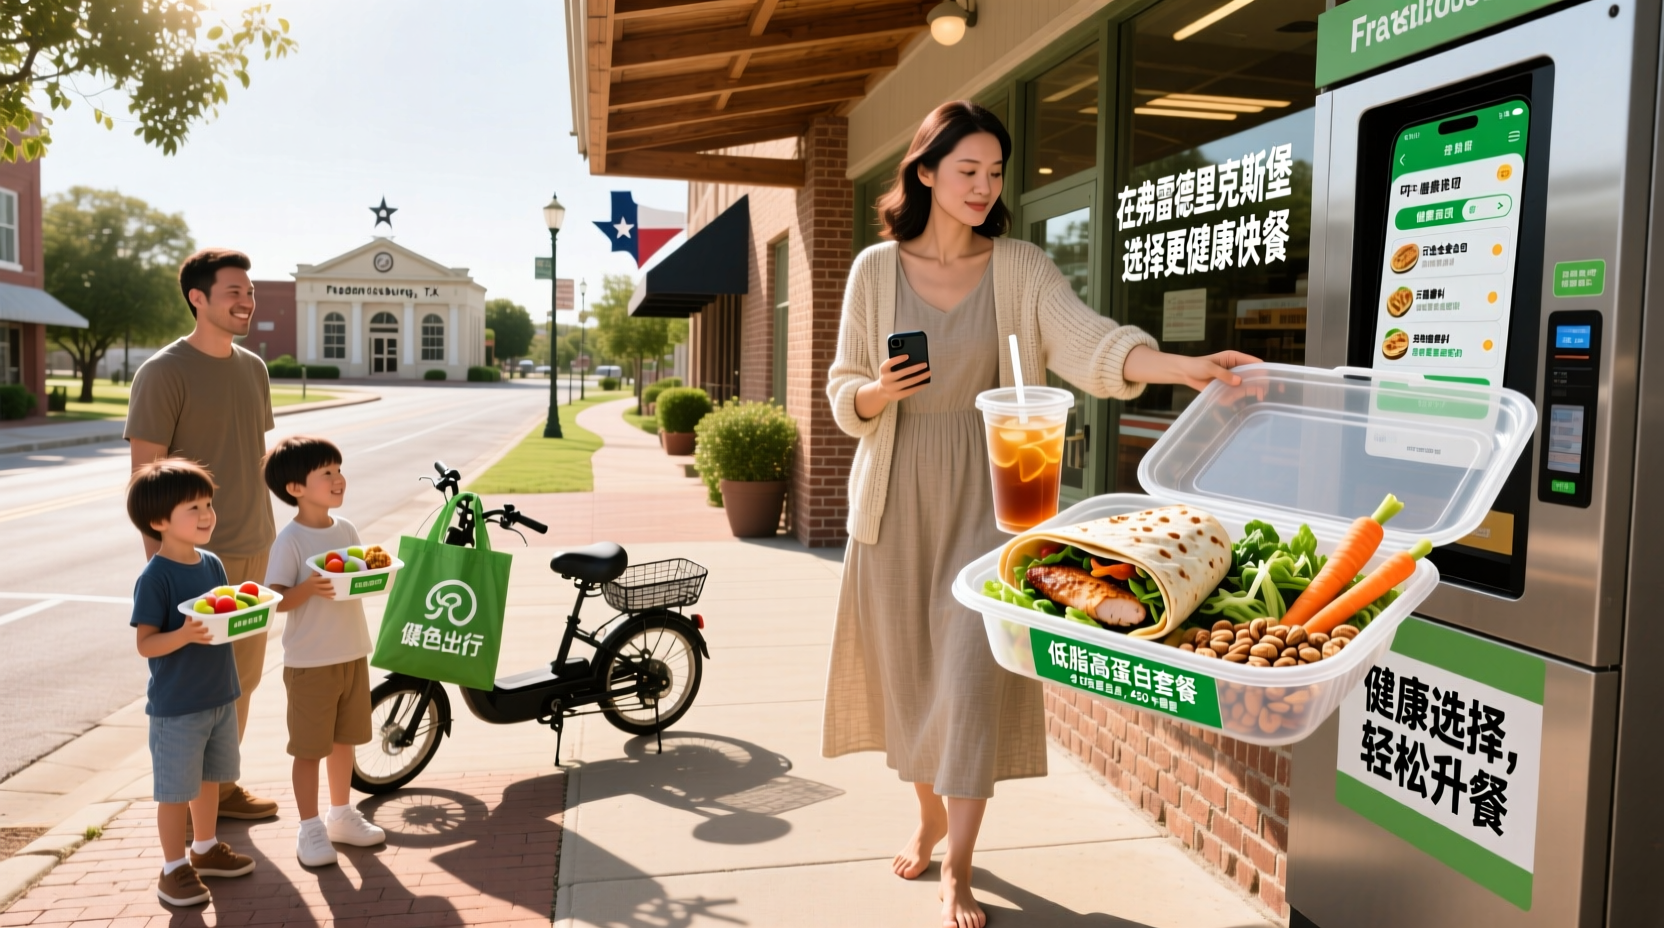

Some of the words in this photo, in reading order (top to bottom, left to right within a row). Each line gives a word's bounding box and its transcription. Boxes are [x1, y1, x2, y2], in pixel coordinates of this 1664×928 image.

[1116, 142, 1293, 232] 在弗雷德里克斯堡
[1121, 208, 1290, 283] 选择更健康快餐
[1047, 639, 1198, 705] 低脂高蛋白套餐
[1360, 719, 1508, 837] 轻松升餐
